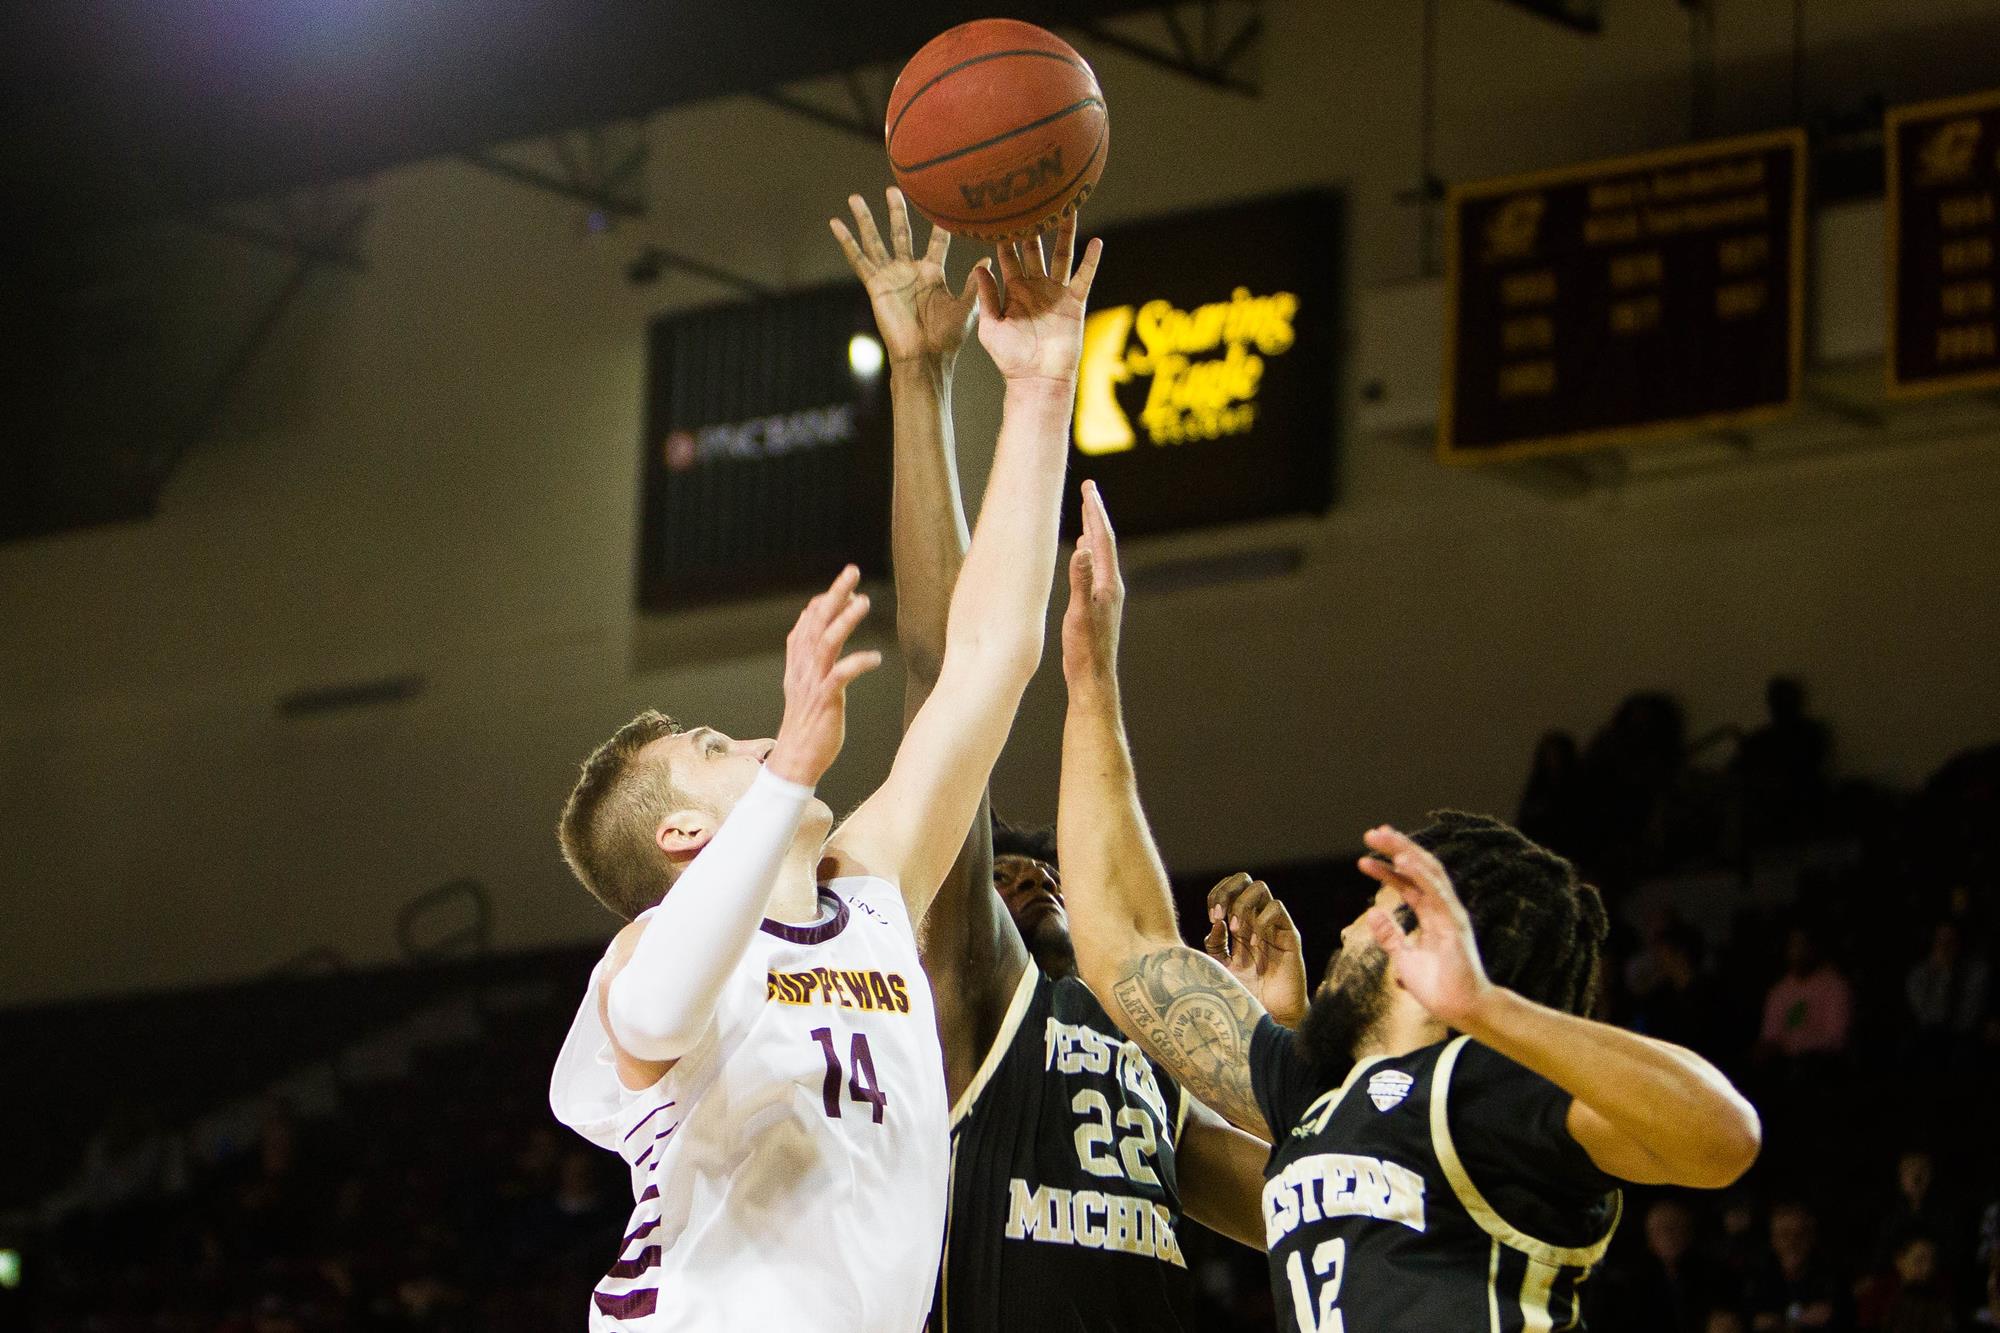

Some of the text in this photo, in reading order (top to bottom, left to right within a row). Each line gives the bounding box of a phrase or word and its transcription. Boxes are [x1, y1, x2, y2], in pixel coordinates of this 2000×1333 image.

[959, 143, 1064, 209] NCAA
[767, 966, 912, 1016] IPPEWAS
[810, 1027, 888, 1125] 14
[1044, 1016, 1176, 1153] ESTER
[1071, 1088, 1162, 1188] 22
[1261, 1153, 1427, 1251] ESTERN
[1286, 1237, 1346, 1333] 12
